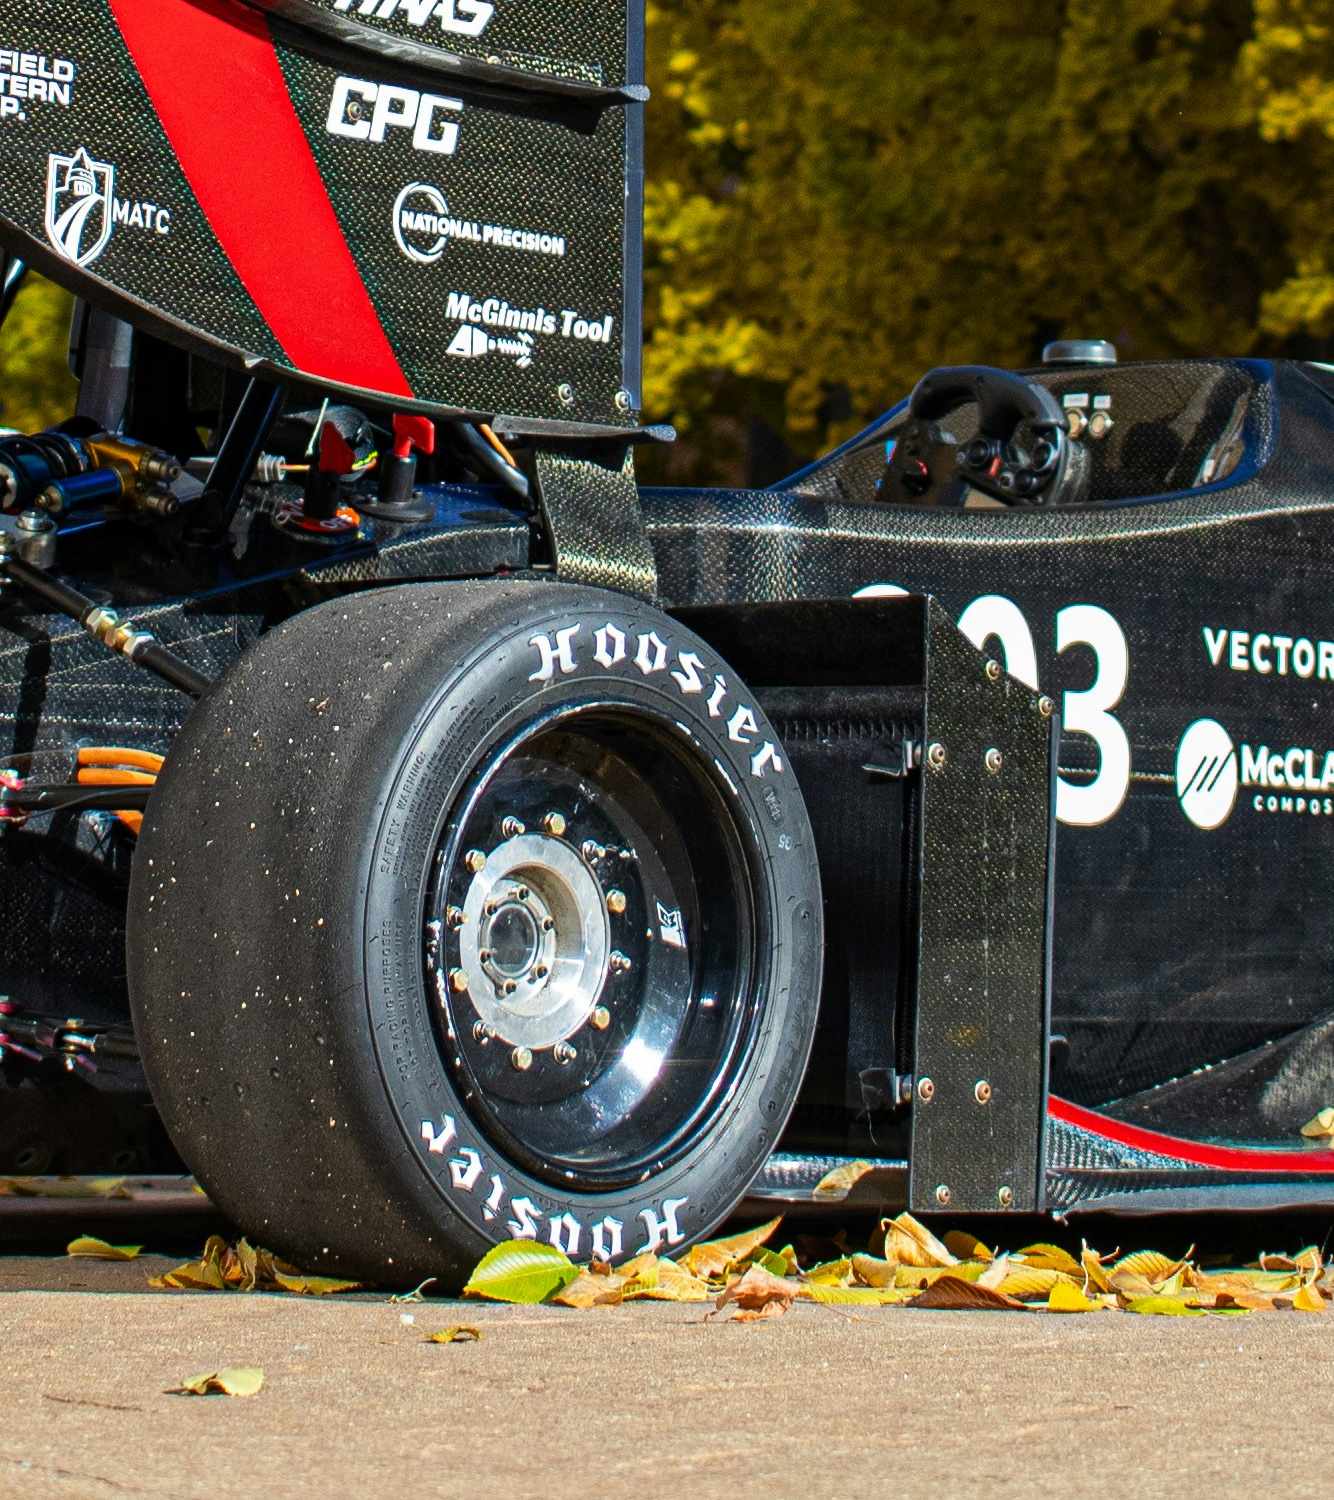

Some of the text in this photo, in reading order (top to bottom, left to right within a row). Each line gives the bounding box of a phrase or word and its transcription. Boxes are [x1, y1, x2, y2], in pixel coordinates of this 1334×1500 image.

[326, 76, 463, 154] CPG
[112, 200, 170, 234] MATC
[400, 210, 565, 255] NATIONAL PRECISION
[445, 291, 613, 343] McGinnis Tool
[527, 620, 784, 780] Hoosier
[420, 1112, 689, 1263] Hoosier
